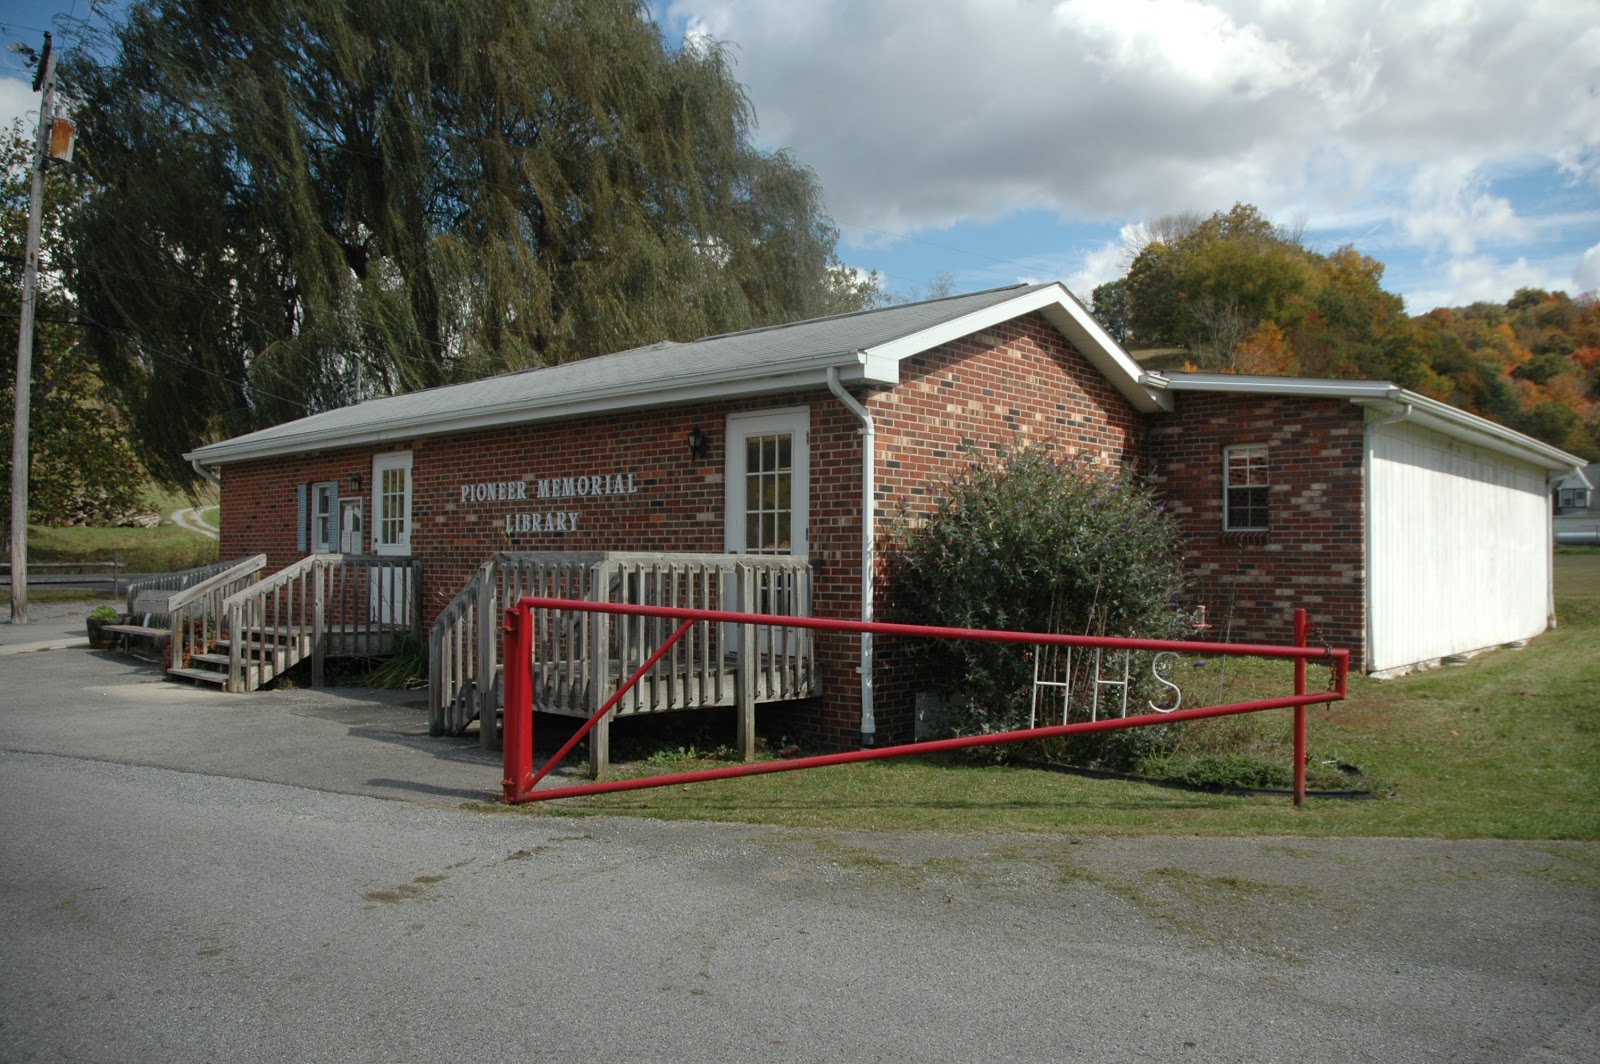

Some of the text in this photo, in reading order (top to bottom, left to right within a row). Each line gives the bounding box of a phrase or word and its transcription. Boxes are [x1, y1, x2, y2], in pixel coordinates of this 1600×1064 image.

[460, 473, 638, 503] PIONEER MEMORIAL
[505, 512, 580, 533] LIBRARY
[1031, 643, 1182, 730] HHS
